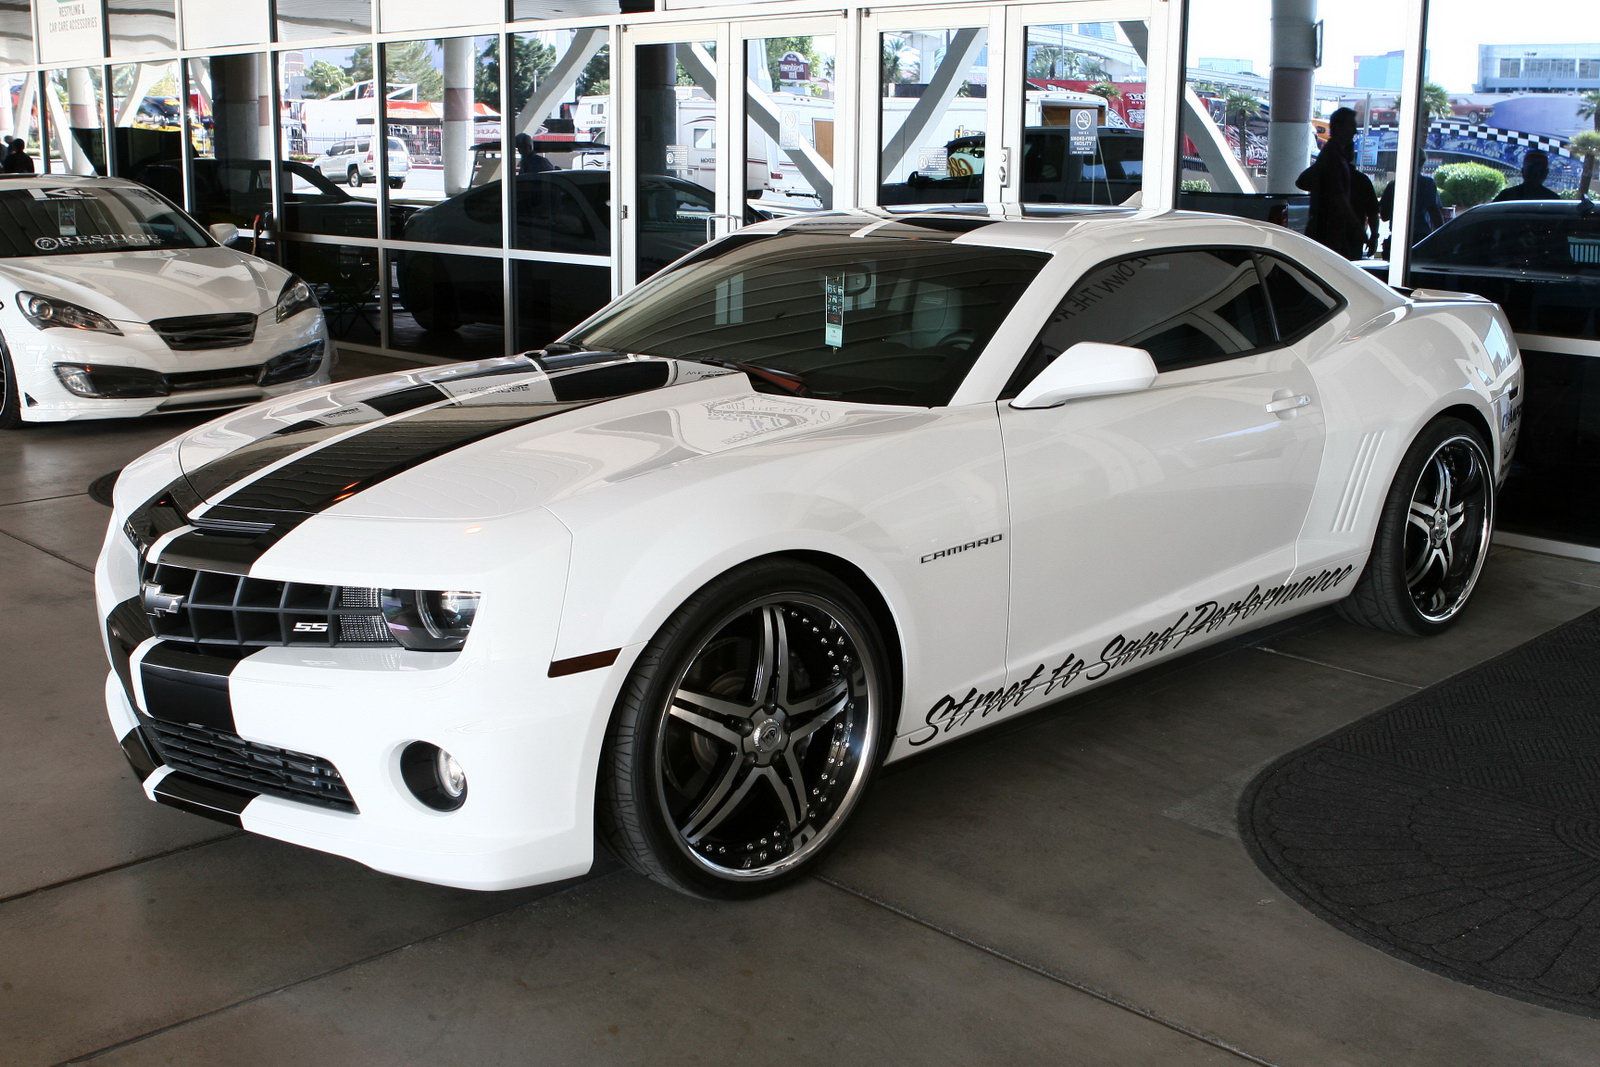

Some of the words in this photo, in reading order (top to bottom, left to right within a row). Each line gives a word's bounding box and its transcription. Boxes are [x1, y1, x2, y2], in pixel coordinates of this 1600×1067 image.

[49, 21, 57, 33] CAR
[58, 20, 69, 32] CARE
[920, 533, 1003, 564] CAMARO
[292, 621, 329, 632] SS
[908, 663, 1045, 747] Street
[1043, 652, 1085, 696] to
[1172, 563, 1358, 650] Performance
